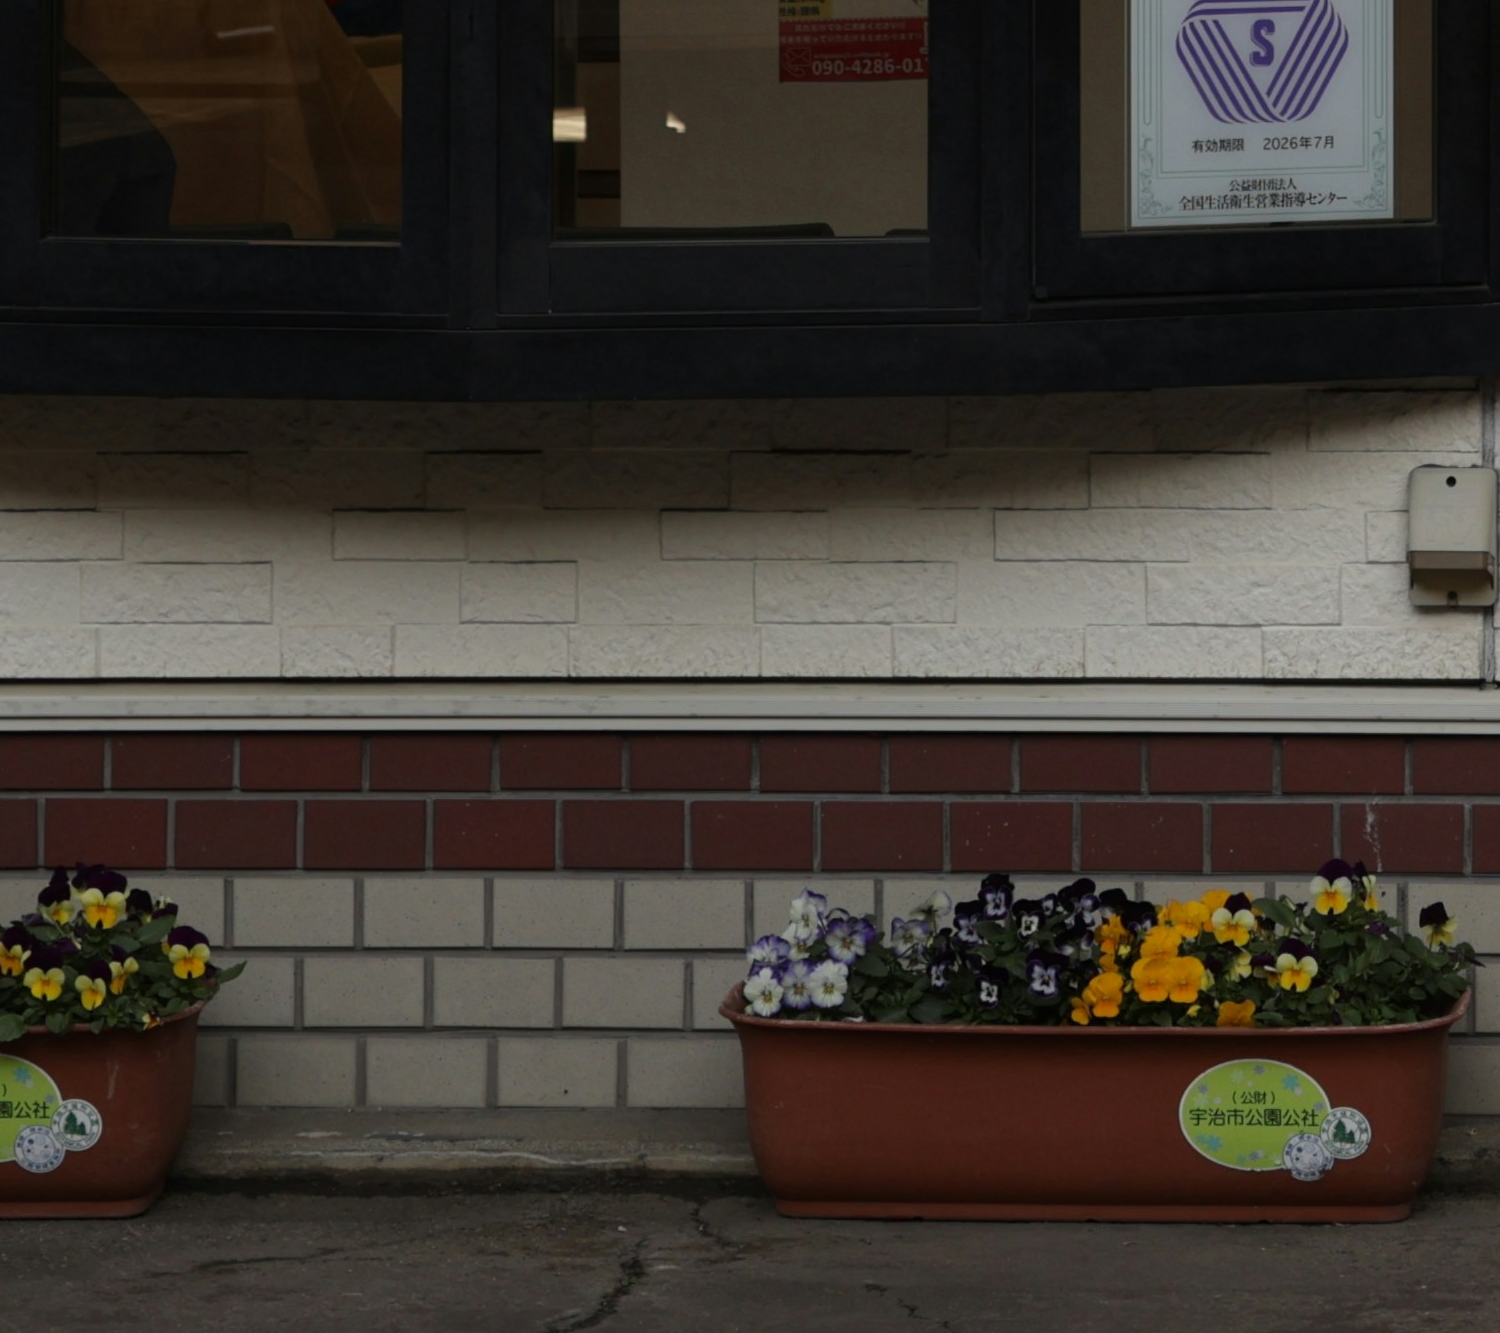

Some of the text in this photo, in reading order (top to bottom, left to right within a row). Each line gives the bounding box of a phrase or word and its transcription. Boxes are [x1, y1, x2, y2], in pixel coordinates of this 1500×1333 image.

[811, 57, 929, 76] 090-4286-01
[1191, 135, 1335, 153] 有効期限 2026年7月
[1228, 177, 1298, 192] 公益財団法人
[1178, 192, 1348, 212] 全国生活衛生営業指導センター
[1189, 1107, 1320, 1128] 宇治市公園公社
